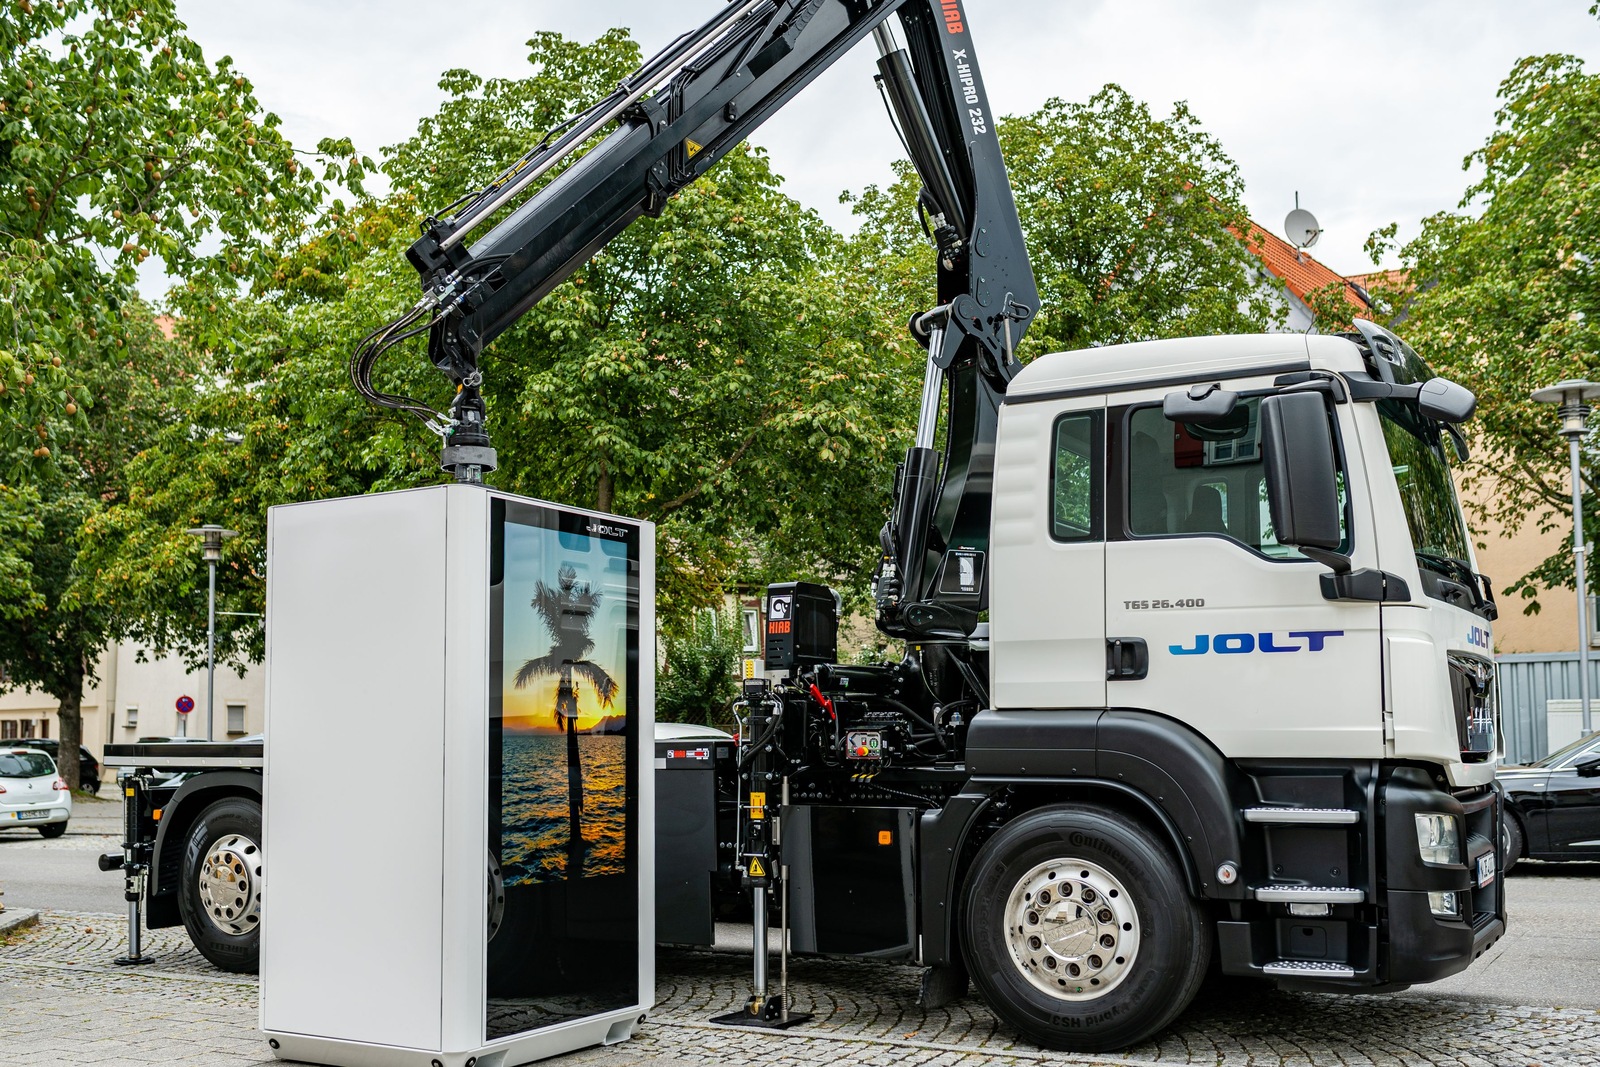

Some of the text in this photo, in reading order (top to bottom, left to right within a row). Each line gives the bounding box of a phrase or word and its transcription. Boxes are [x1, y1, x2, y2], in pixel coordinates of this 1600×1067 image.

[952, 48, 987, 135] X-HIPRO 232
[586, 523, 628, 537] JOLT
[1152, 598, 1205, 609] 26.400
[768, 621, 791, 634] HIAB
[1466, 625, 1490, 649] JOLT
[1168, 630, 1344, 656] JOLT
[1068, 831, 1146, 880] Continental
[1051, 1014, 1080, 1028] HS3
